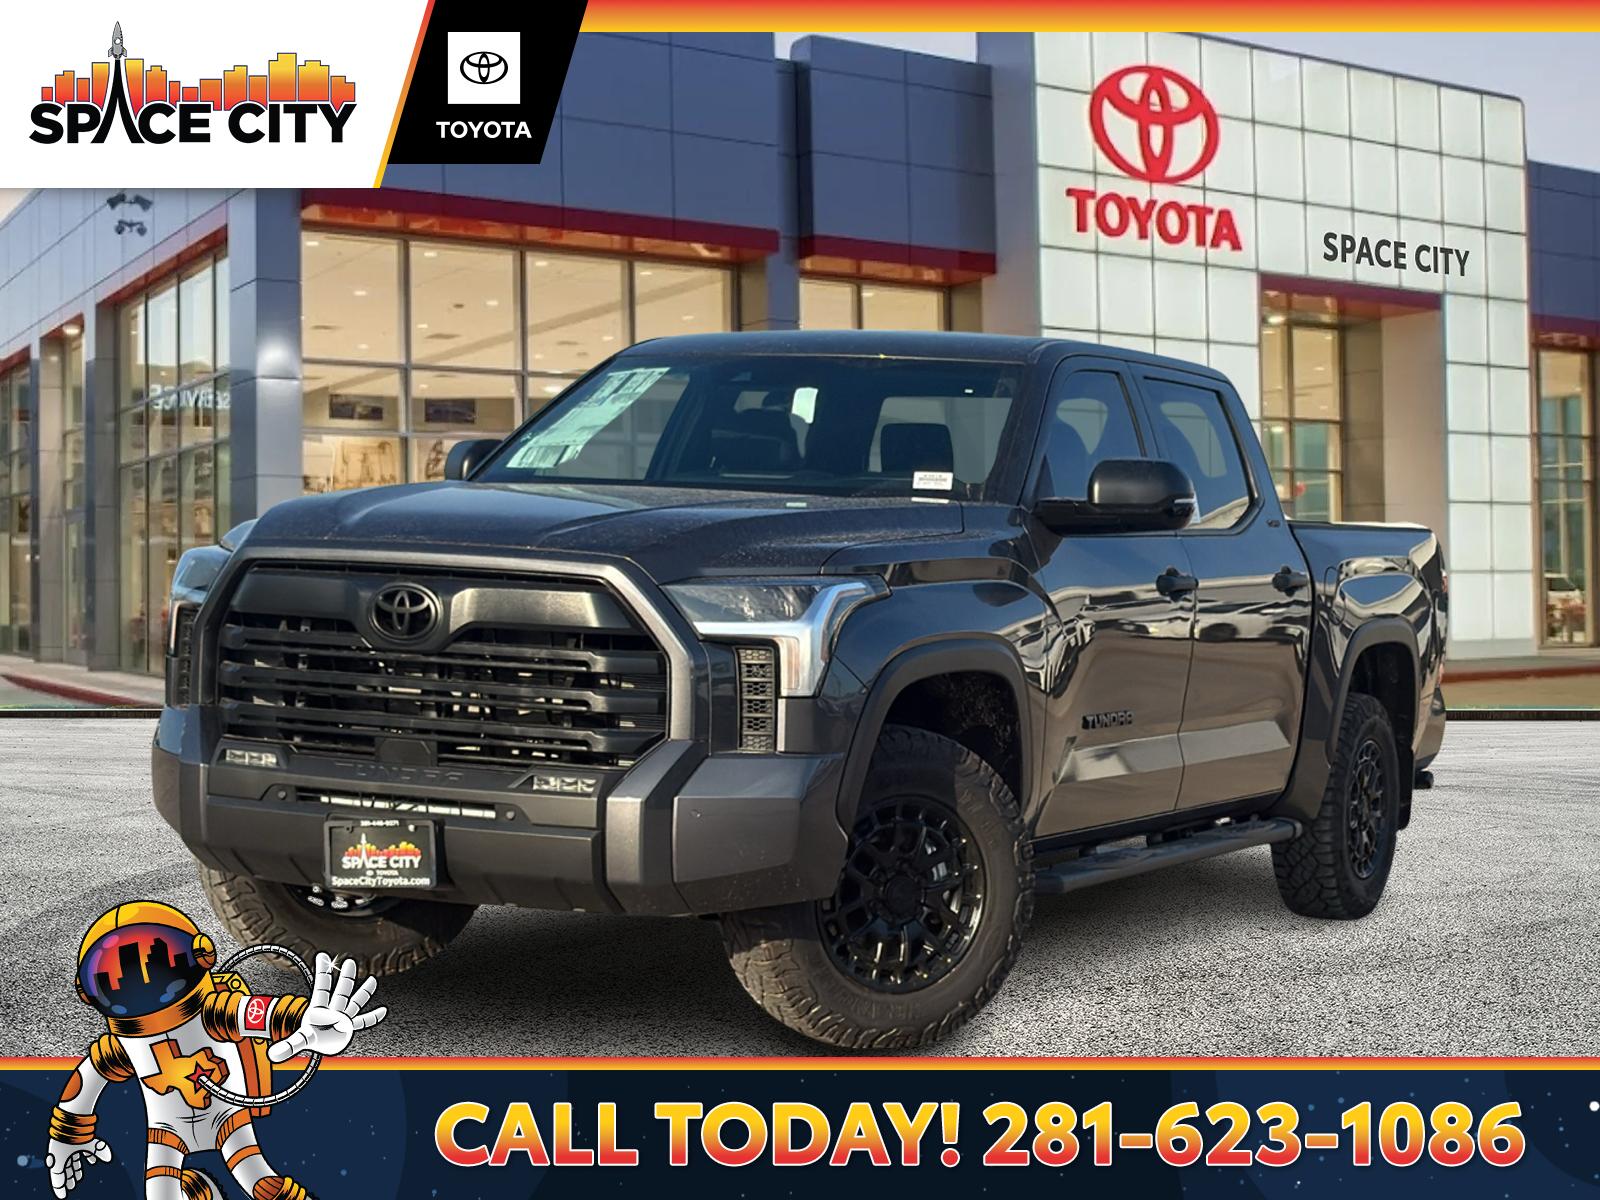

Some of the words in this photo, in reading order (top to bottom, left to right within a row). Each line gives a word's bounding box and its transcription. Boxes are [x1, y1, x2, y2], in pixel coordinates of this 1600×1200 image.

[1065, 187, 1242, 251] TOYOTA
[1323, 232, 1407, 270] SPACE
[1414, 244, 1470, 277] CITY
[341, 854, 387, 869] SPACE
[389, 854, 421, 869] CITY
[331, 876, 430, 887] SpaceCityToyota.com
